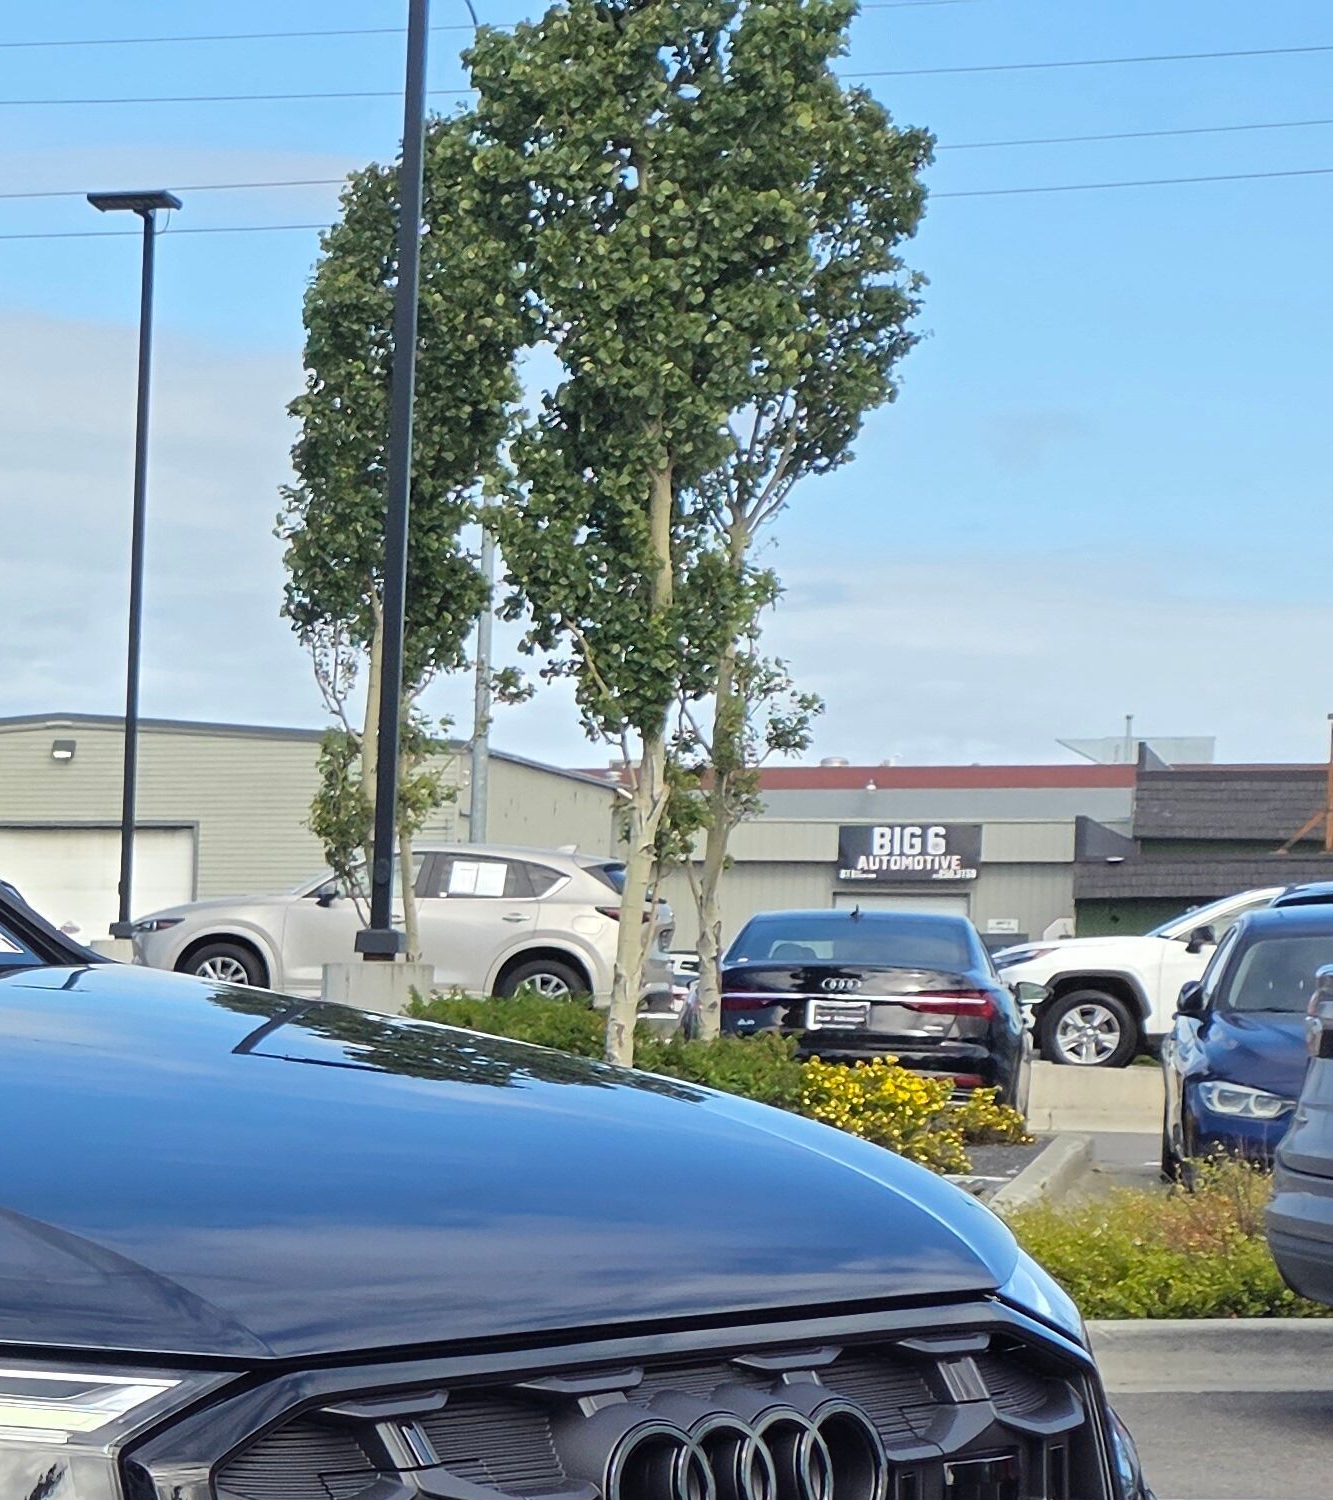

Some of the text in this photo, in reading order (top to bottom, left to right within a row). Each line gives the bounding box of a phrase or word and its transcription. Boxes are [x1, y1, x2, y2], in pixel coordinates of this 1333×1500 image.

[873, 826, 946, 855] BIG 6
[857, 855, 962, 870] AUTOMOTIVE
